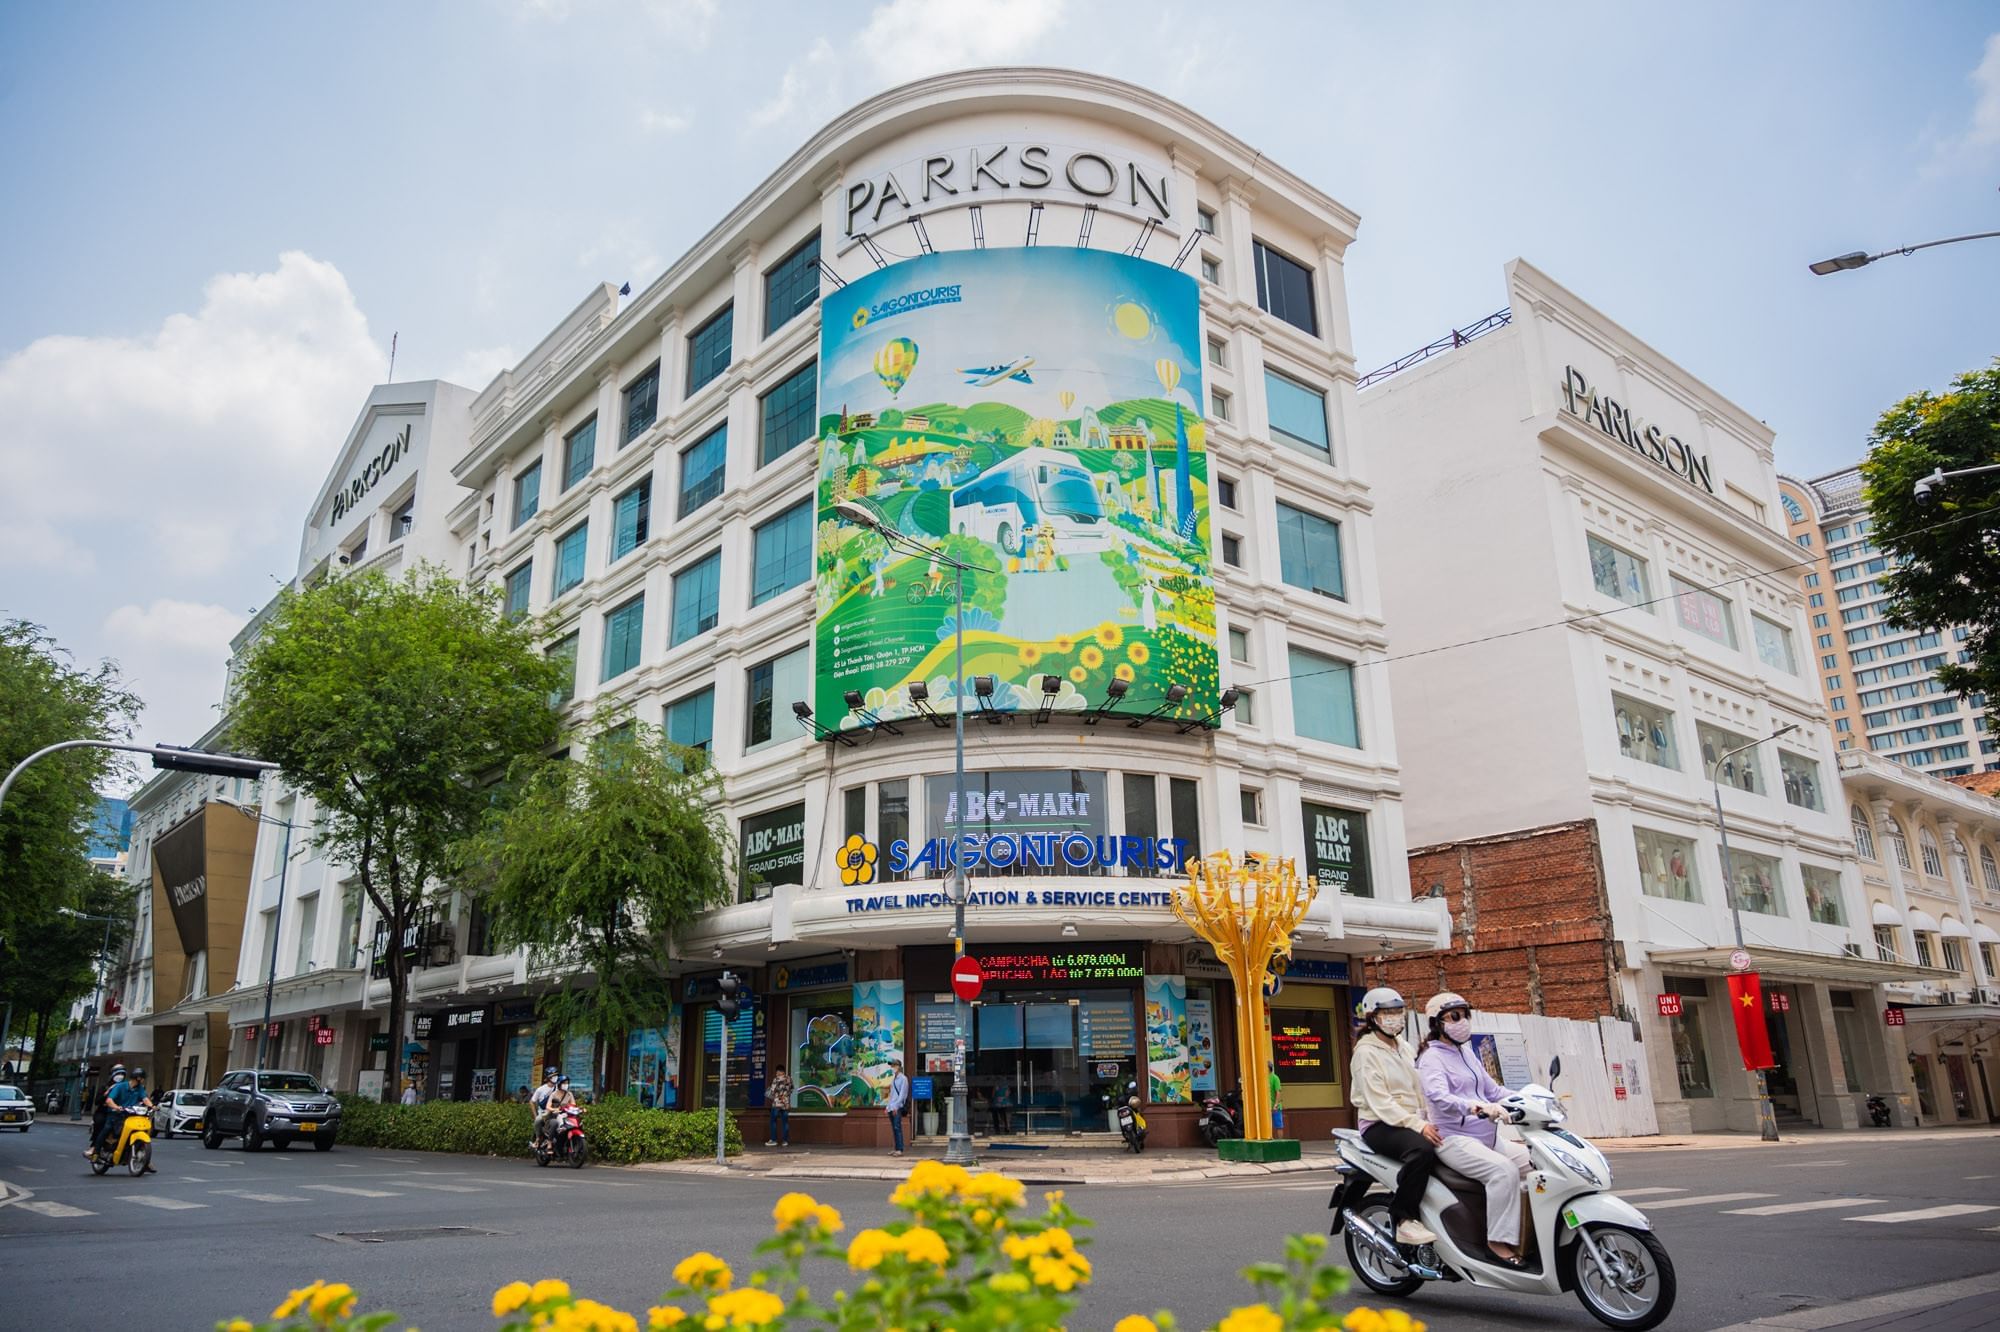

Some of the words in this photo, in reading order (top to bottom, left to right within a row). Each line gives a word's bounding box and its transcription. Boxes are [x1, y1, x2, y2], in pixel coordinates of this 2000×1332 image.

[845, 145, 1171, 235] PARKSON
[871, 284, 962, 316] SAIGONTOURIST
[1565, 364, 1714, 494] PARKSON
[330, 423, 412, 527] PARKSON
[901, 645, 925, 654] TP.HCM
[876, 661, 884, 669] 38
[898, 656, 911, 665] 279
[944, 790, 1091, 822] ABC-MART
[1315, 814, 1350, 844] ABC
[749, 859, 777, 874] GRAND
[778, 852, 805, 868] STAGE
[888, 834, 1189, 873] SAIGONTOURIST
[1316, 841, 1351, 863] MART
[1318, 868, 1349, 881] GRAND
[846, 895, 902, 913] TRAVEL
[906, 891, 1019, 908] INFORATION
[1026, 891, 1038, 905] &
[1042, 891, 1115, 906] SERVICE
[1660, 996, 1676, 1005] UNI
[1661, 1005, 1679, 1015] QLO
[317, 1036, 332, 1044] QLO
